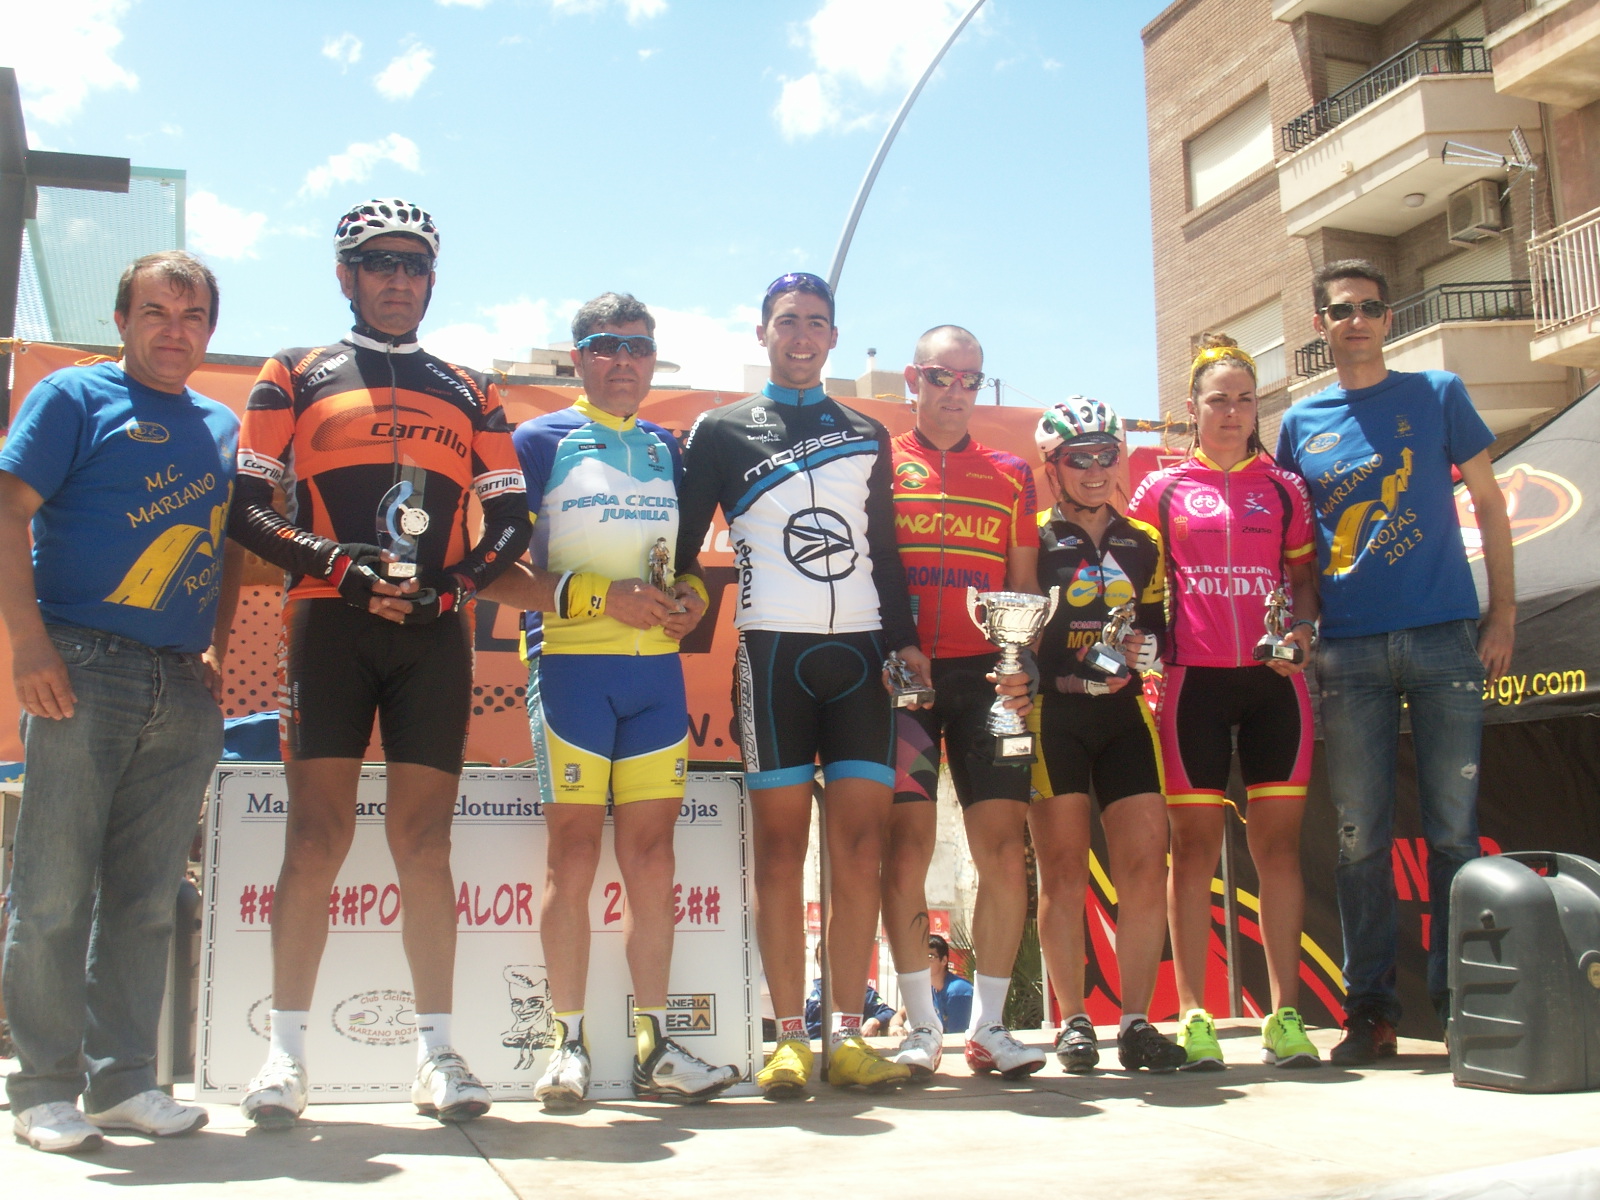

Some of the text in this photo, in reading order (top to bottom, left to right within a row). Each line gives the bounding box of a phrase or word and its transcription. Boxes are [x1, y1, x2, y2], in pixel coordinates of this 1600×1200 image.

[301, 353, 349, 392] arrillo
[145, 464, 183, 492] M.C.
[1317, 460, 1352, 489] M.C.
[1321, 453, 1384, 519] MARIANO
[126, 472, 216, 529] MARIANO
[1366, 507, 1418, 555] ROJAS
[1384, 528, 1424, 566] 2013
[906, 566, 991, 591] ROMAINSA
[679, 798, 718, 824] ojas
[455, 881, 532, 926] ALOR
[666, 998, 710, 1008] ANERIA
[394, 1026, 418, 1036] ROJA
[665, 1013, 711, 1027] ERA
